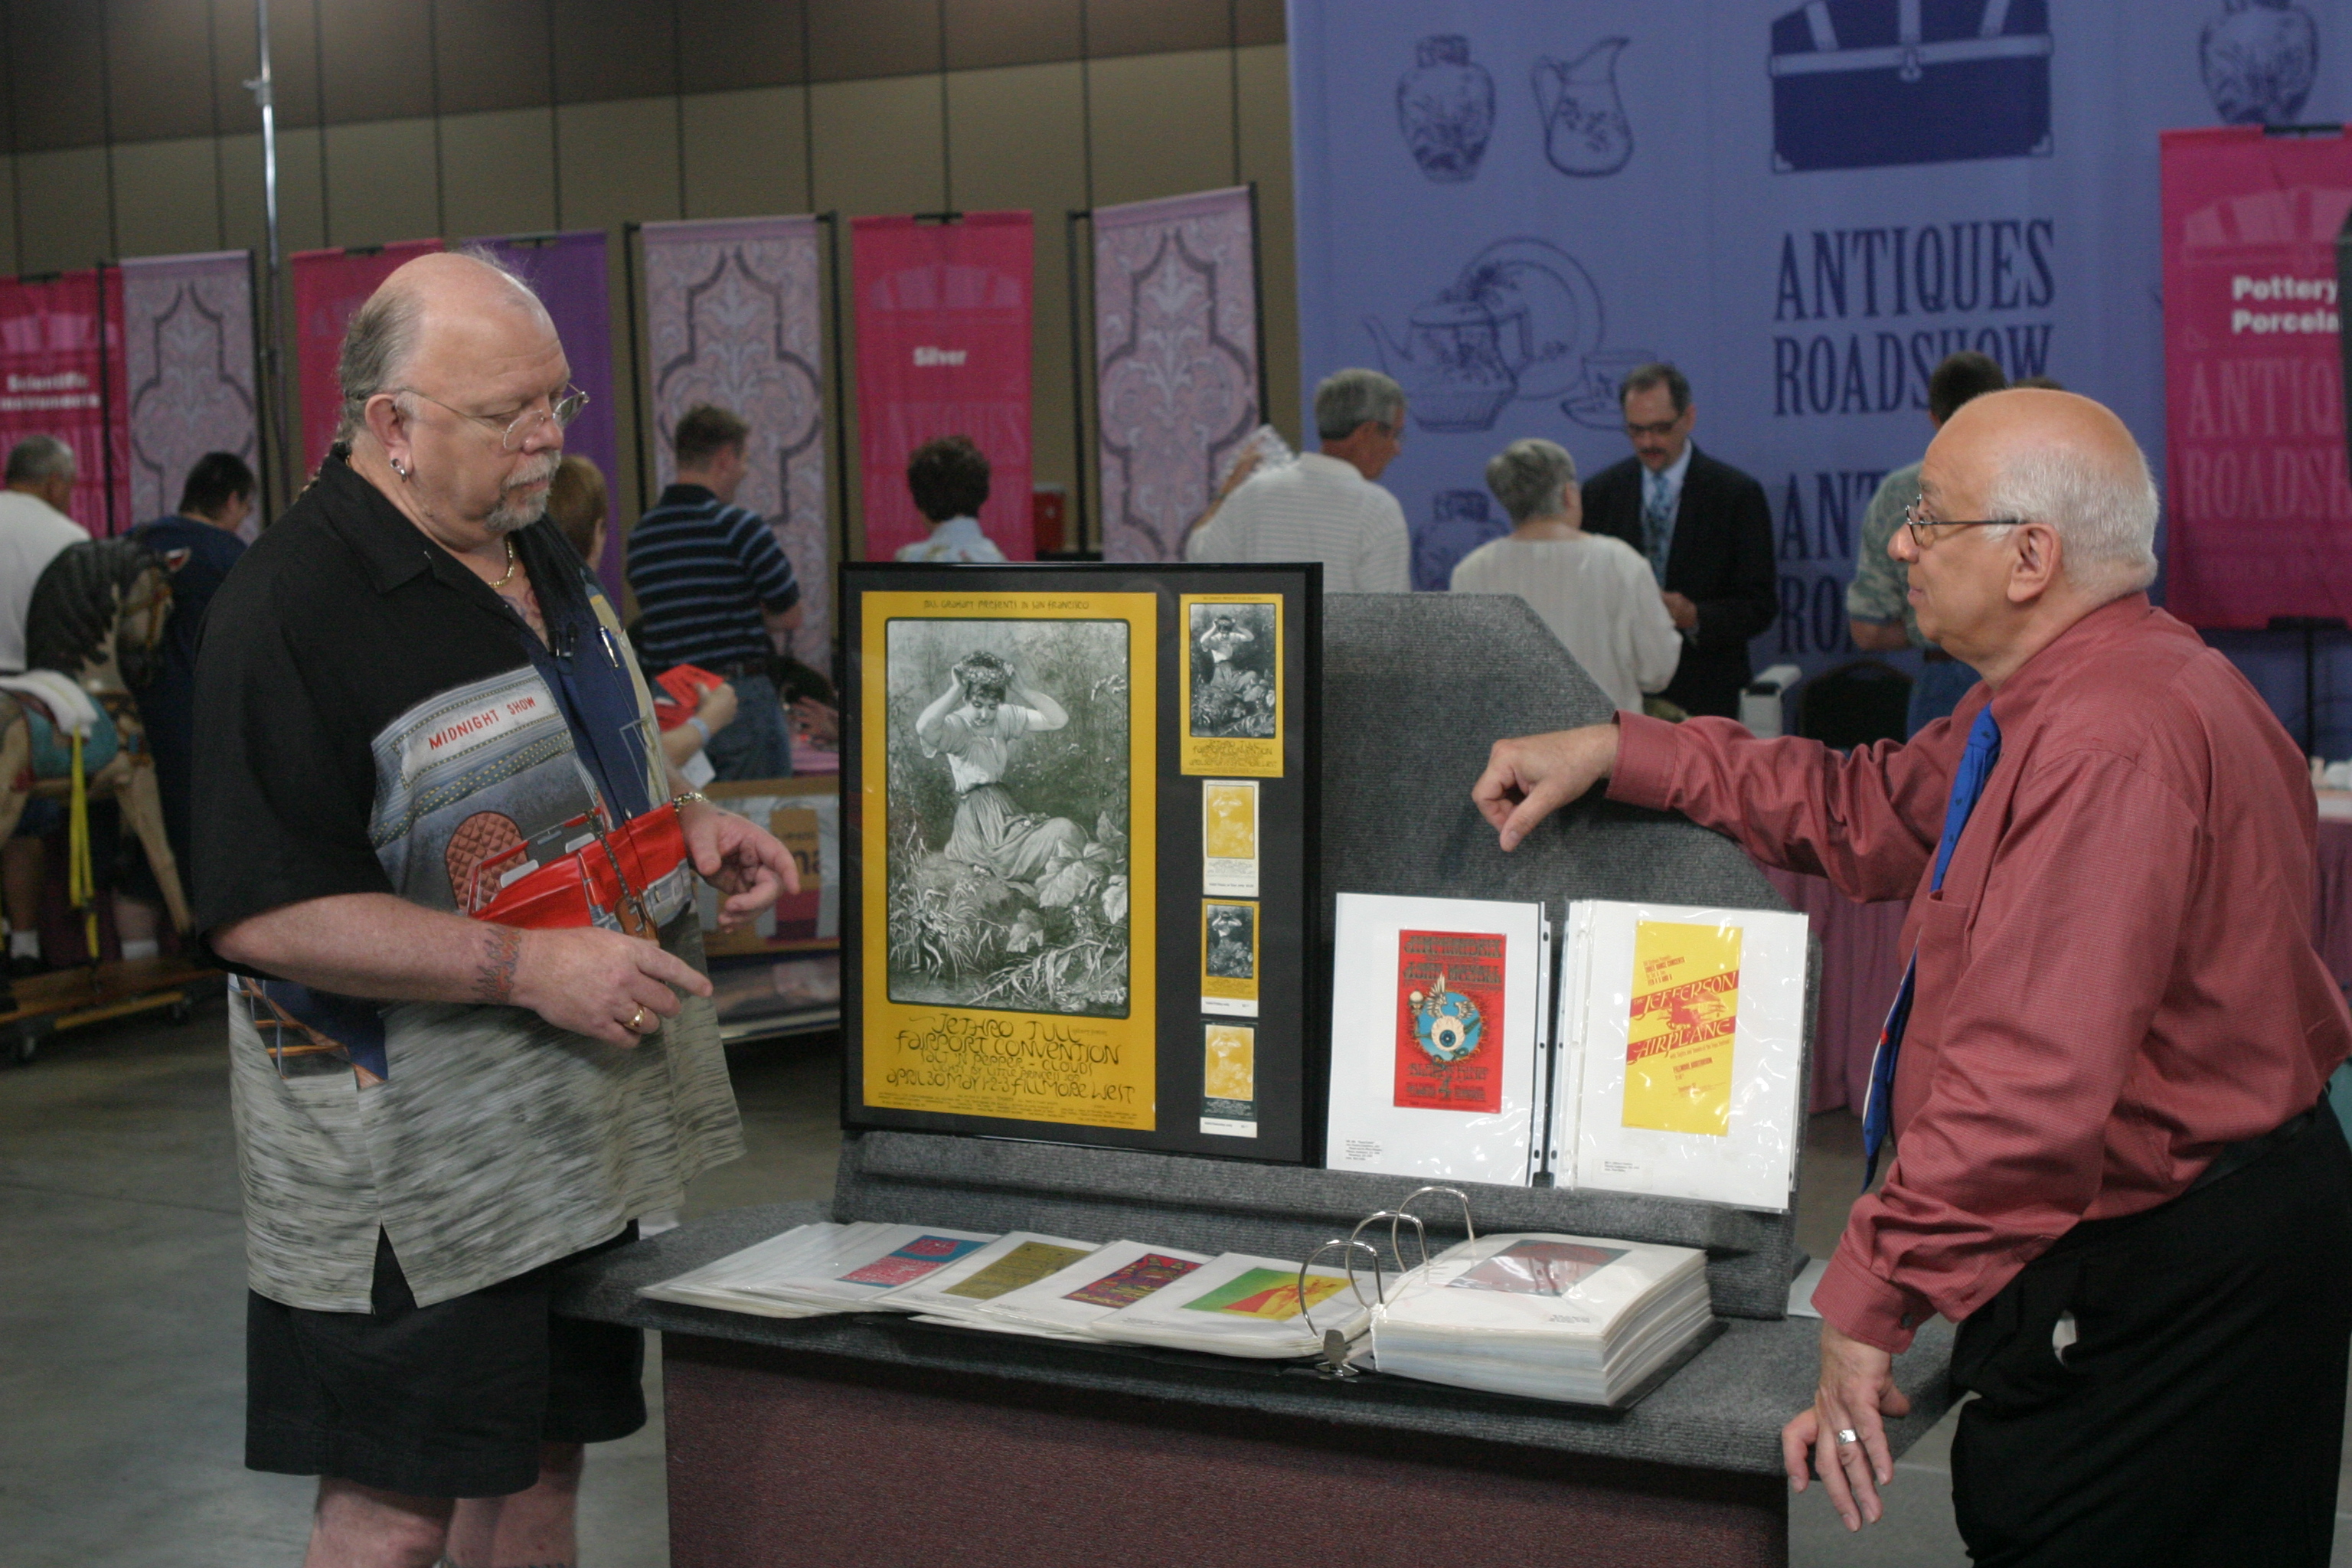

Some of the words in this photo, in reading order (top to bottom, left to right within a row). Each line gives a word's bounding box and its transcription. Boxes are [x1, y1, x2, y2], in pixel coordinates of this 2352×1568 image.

[1773, 219, 2055, 322] ANTIQUES
[2232, 274, 2338, 305] Pottery
[428, 709, 500, 750] MIDNIGHT
[506, 696, 537, 715] SHOW
[1633, 970, 1737, 1021] JEFFERSON
[919, 1013, 1014, 1038] JETHRO
[1027, 1021, 1081, 1044] TULL
[1627, 1018, 1731, 1065] AIRPLANE
[894, 1030, 988, 1055] FAIRPORT
[995, 1036, 1122, 1066] CONVENTION
[973, 1054, 1024, 1070] PEPPER
[1042, 1060, 1094, 1076] CLOUDS
[886, 1067, 926, 1087] APRIL
[926, 1070, 946, 1087] 30
[944, 1072, 981, 1093] MAY
[1011, 1077, 1089, 1099] FILLMORE
[1090, 1082, 1136, 1105] WEST
